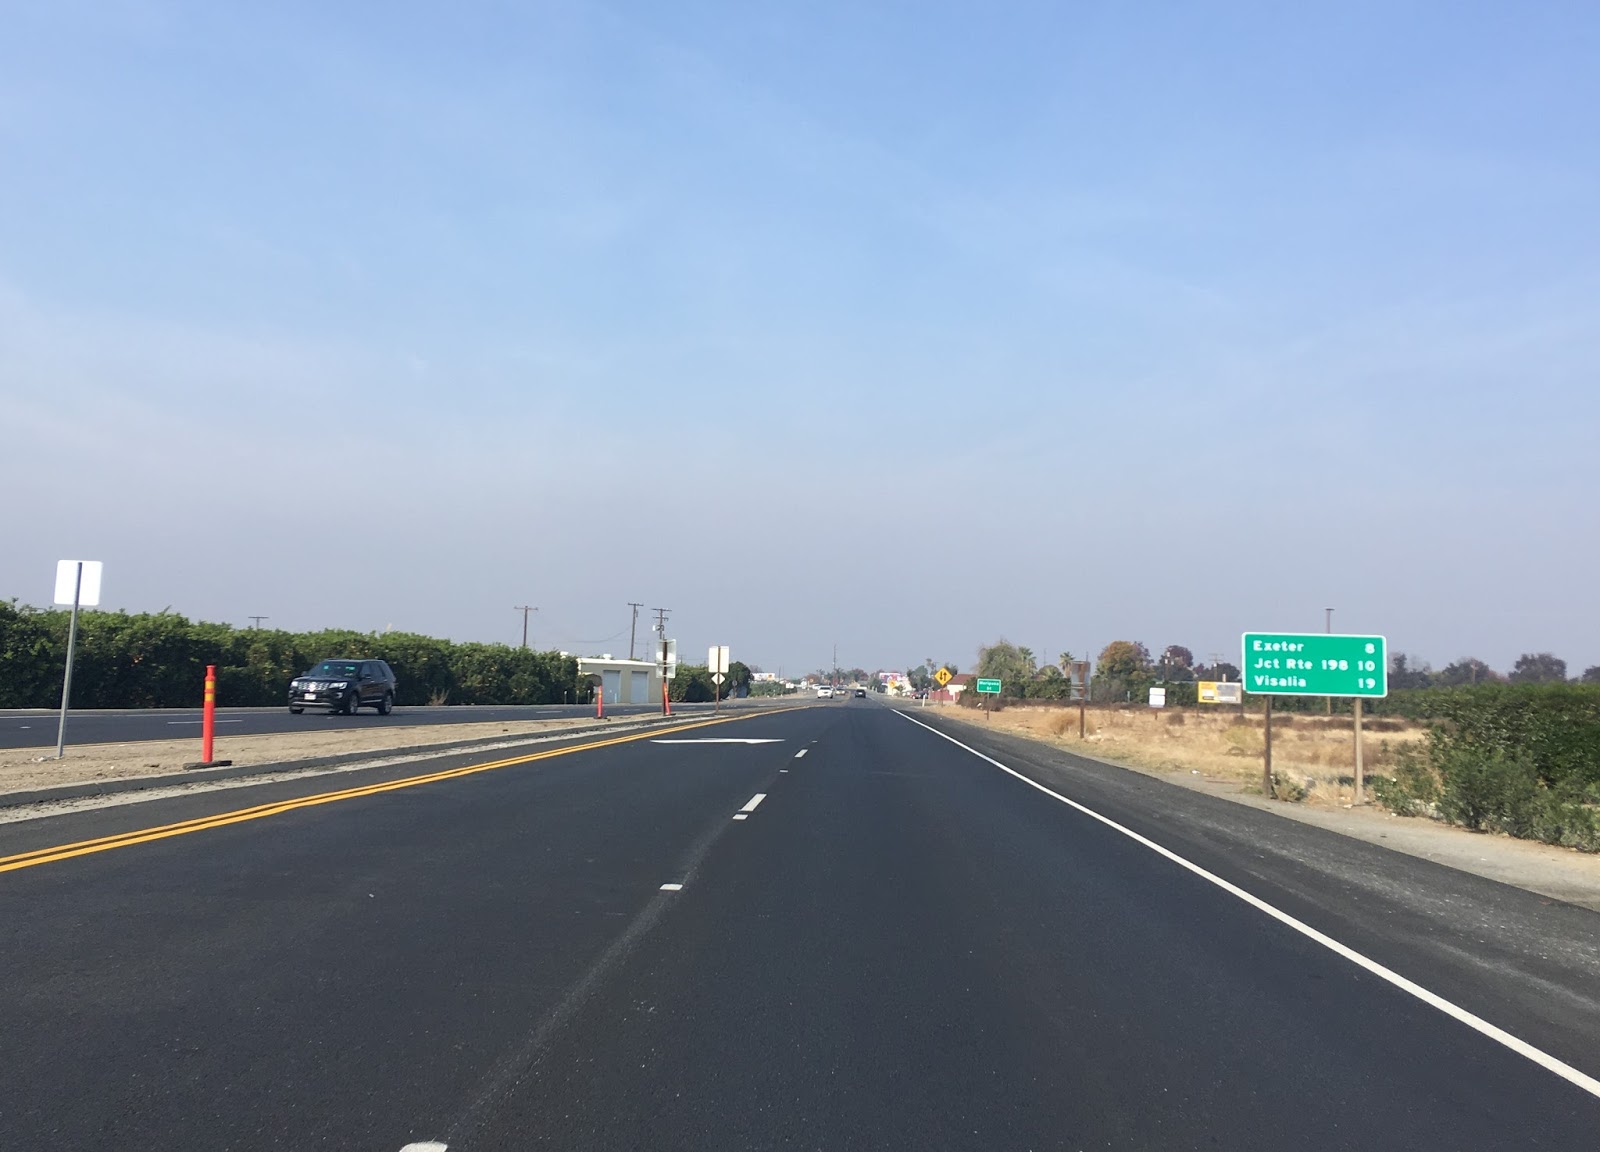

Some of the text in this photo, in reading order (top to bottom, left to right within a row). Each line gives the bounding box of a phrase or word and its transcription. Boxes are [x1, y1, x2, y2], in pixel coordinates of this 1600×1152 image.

[1253, 640, 1304, 652] Exeter
[1365, 643, 1375, 654] 8
[1254, 658, 1349, 671] Jct Rte 198
[1357, 660, 1375, 672] 10
[1254, 675, 1307, 687] Visalia
[1358, 678, 1376, 689] 19
